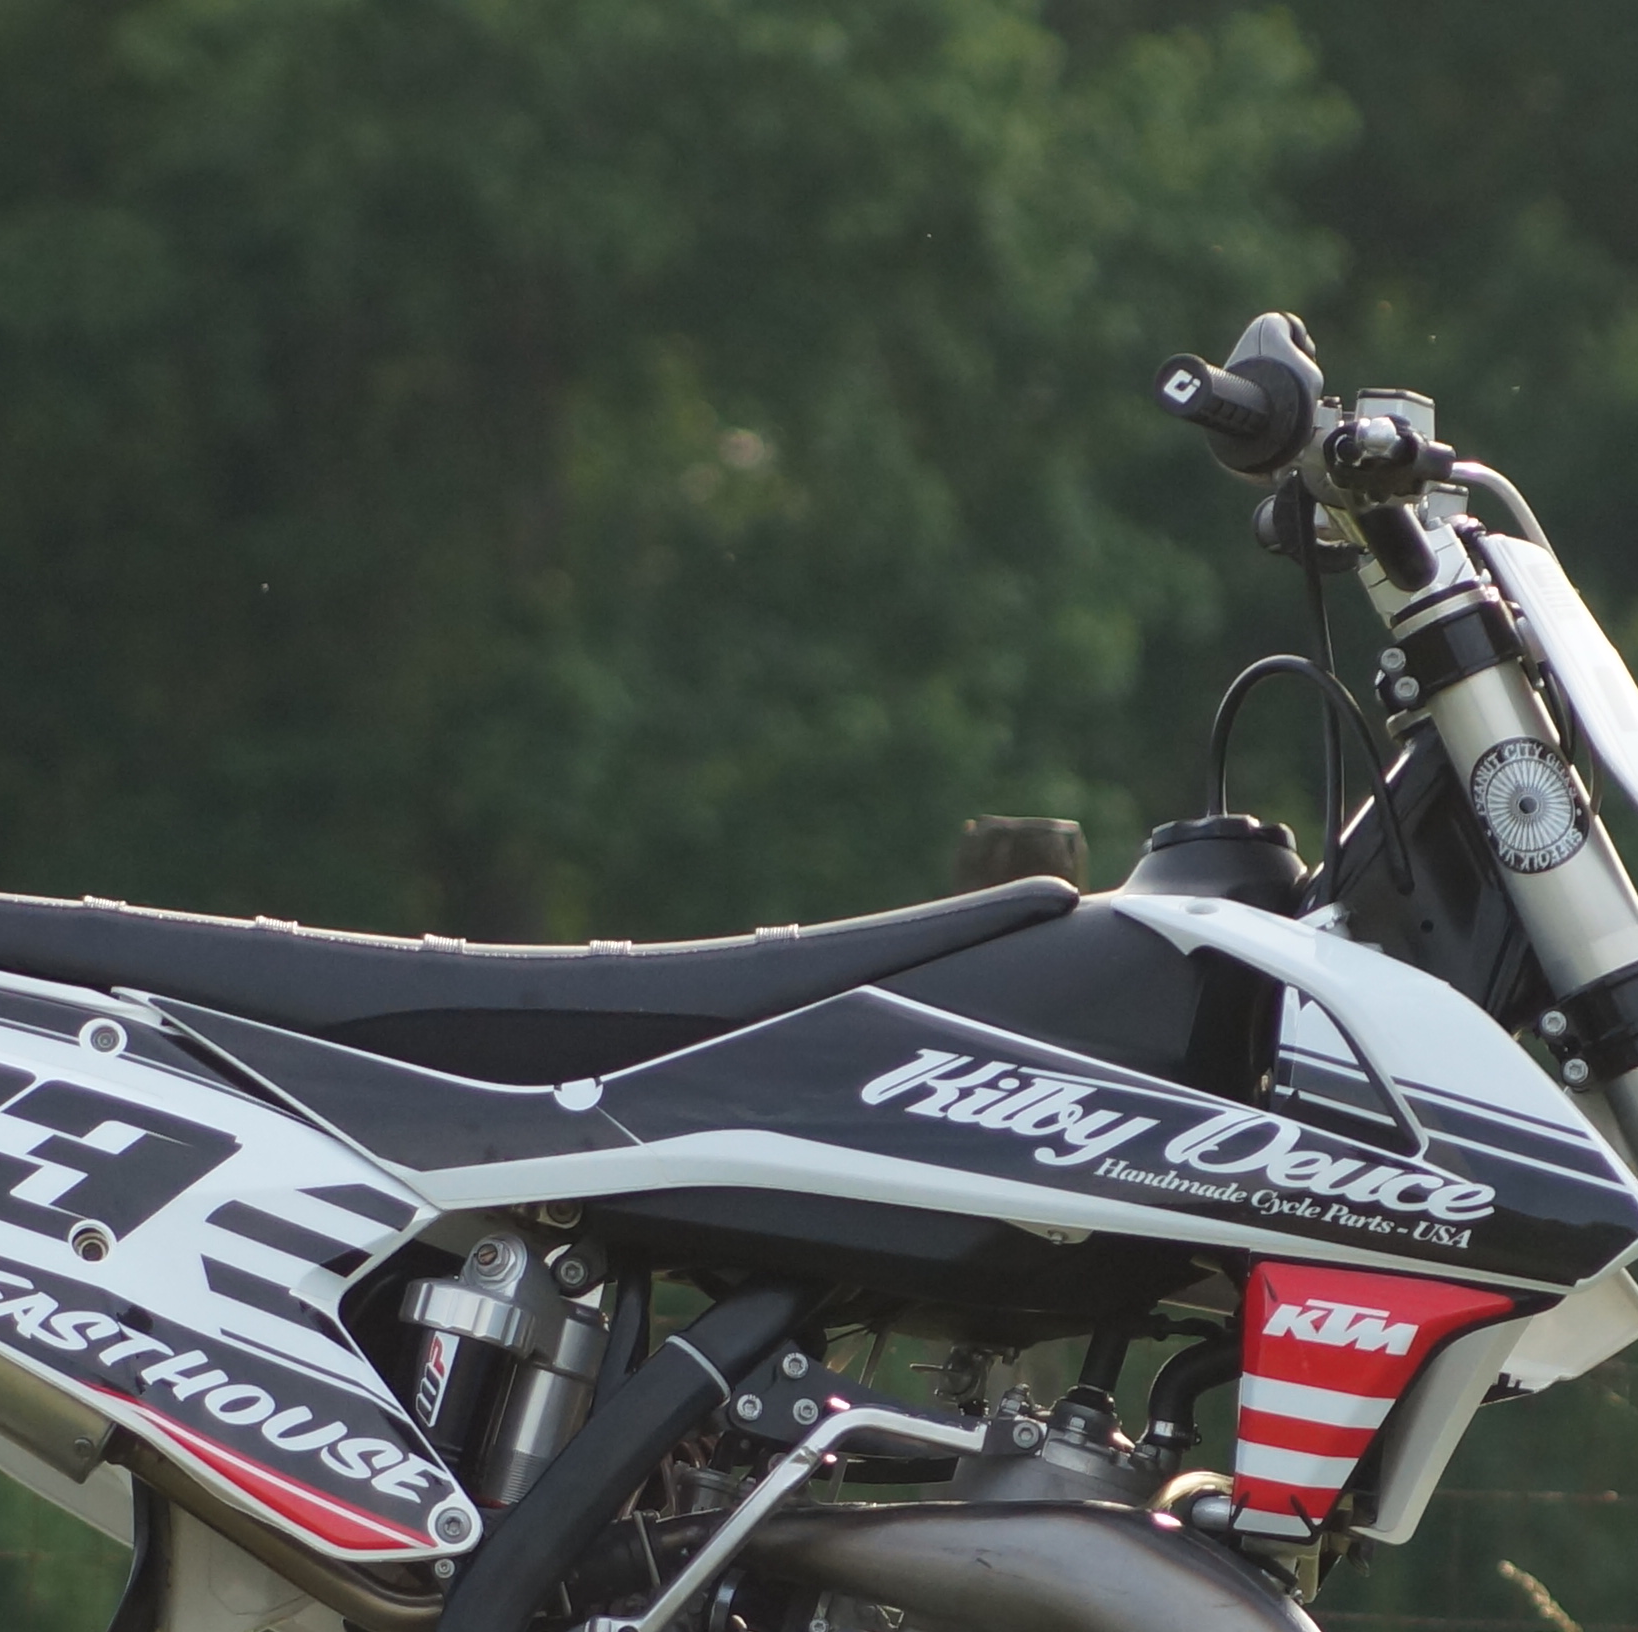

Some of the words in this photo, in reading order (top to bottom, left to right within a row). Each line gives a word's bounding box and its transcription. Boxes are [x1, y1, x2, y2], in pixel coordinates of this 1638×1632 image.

[1504, 742, 1543, 760] CITY
[861, 1048, 1162, 1166] Kilby
[1164, 1104, 1496, 1220] Deuce
[1093, 1157, 1249, 1204] Handmade
[1251, 1188, 1321, 1220] Cycle
[1320, 1203, 1396, 1235] Parts
[1412, 1221, 1472, 1248] USA
[1262, 1298, 1420, 1356] KTM
